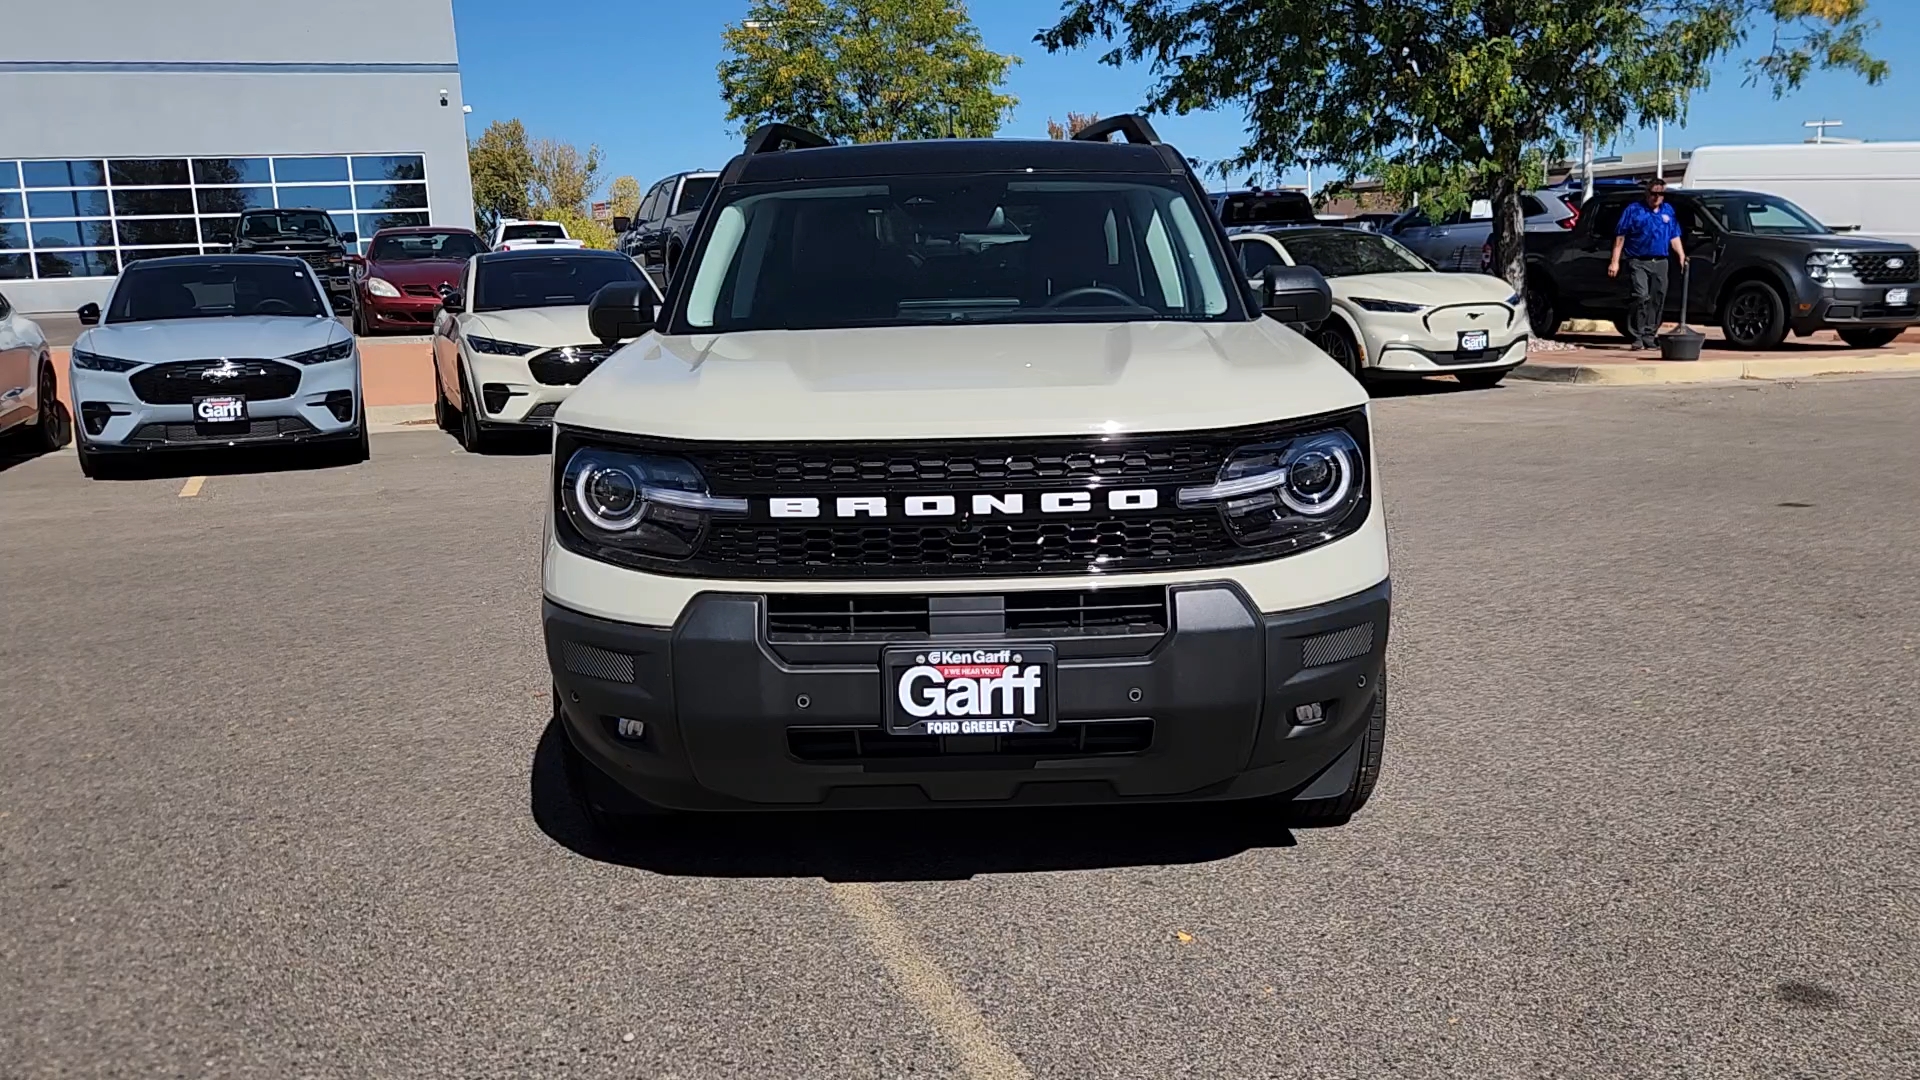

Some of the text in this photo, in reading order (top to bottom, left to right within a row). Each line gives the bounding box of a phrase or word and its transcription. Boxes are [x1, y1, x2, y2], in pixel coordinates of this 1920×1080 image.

[198, 400, 242, 418] Garff
[769, 489, 1158, 517] BRONCO
[942, 650, 1012, 664] Ken Garff
[899, 665, 1041, 717] Garff
[927, 720, 1016, 734] FORD GREELEY
